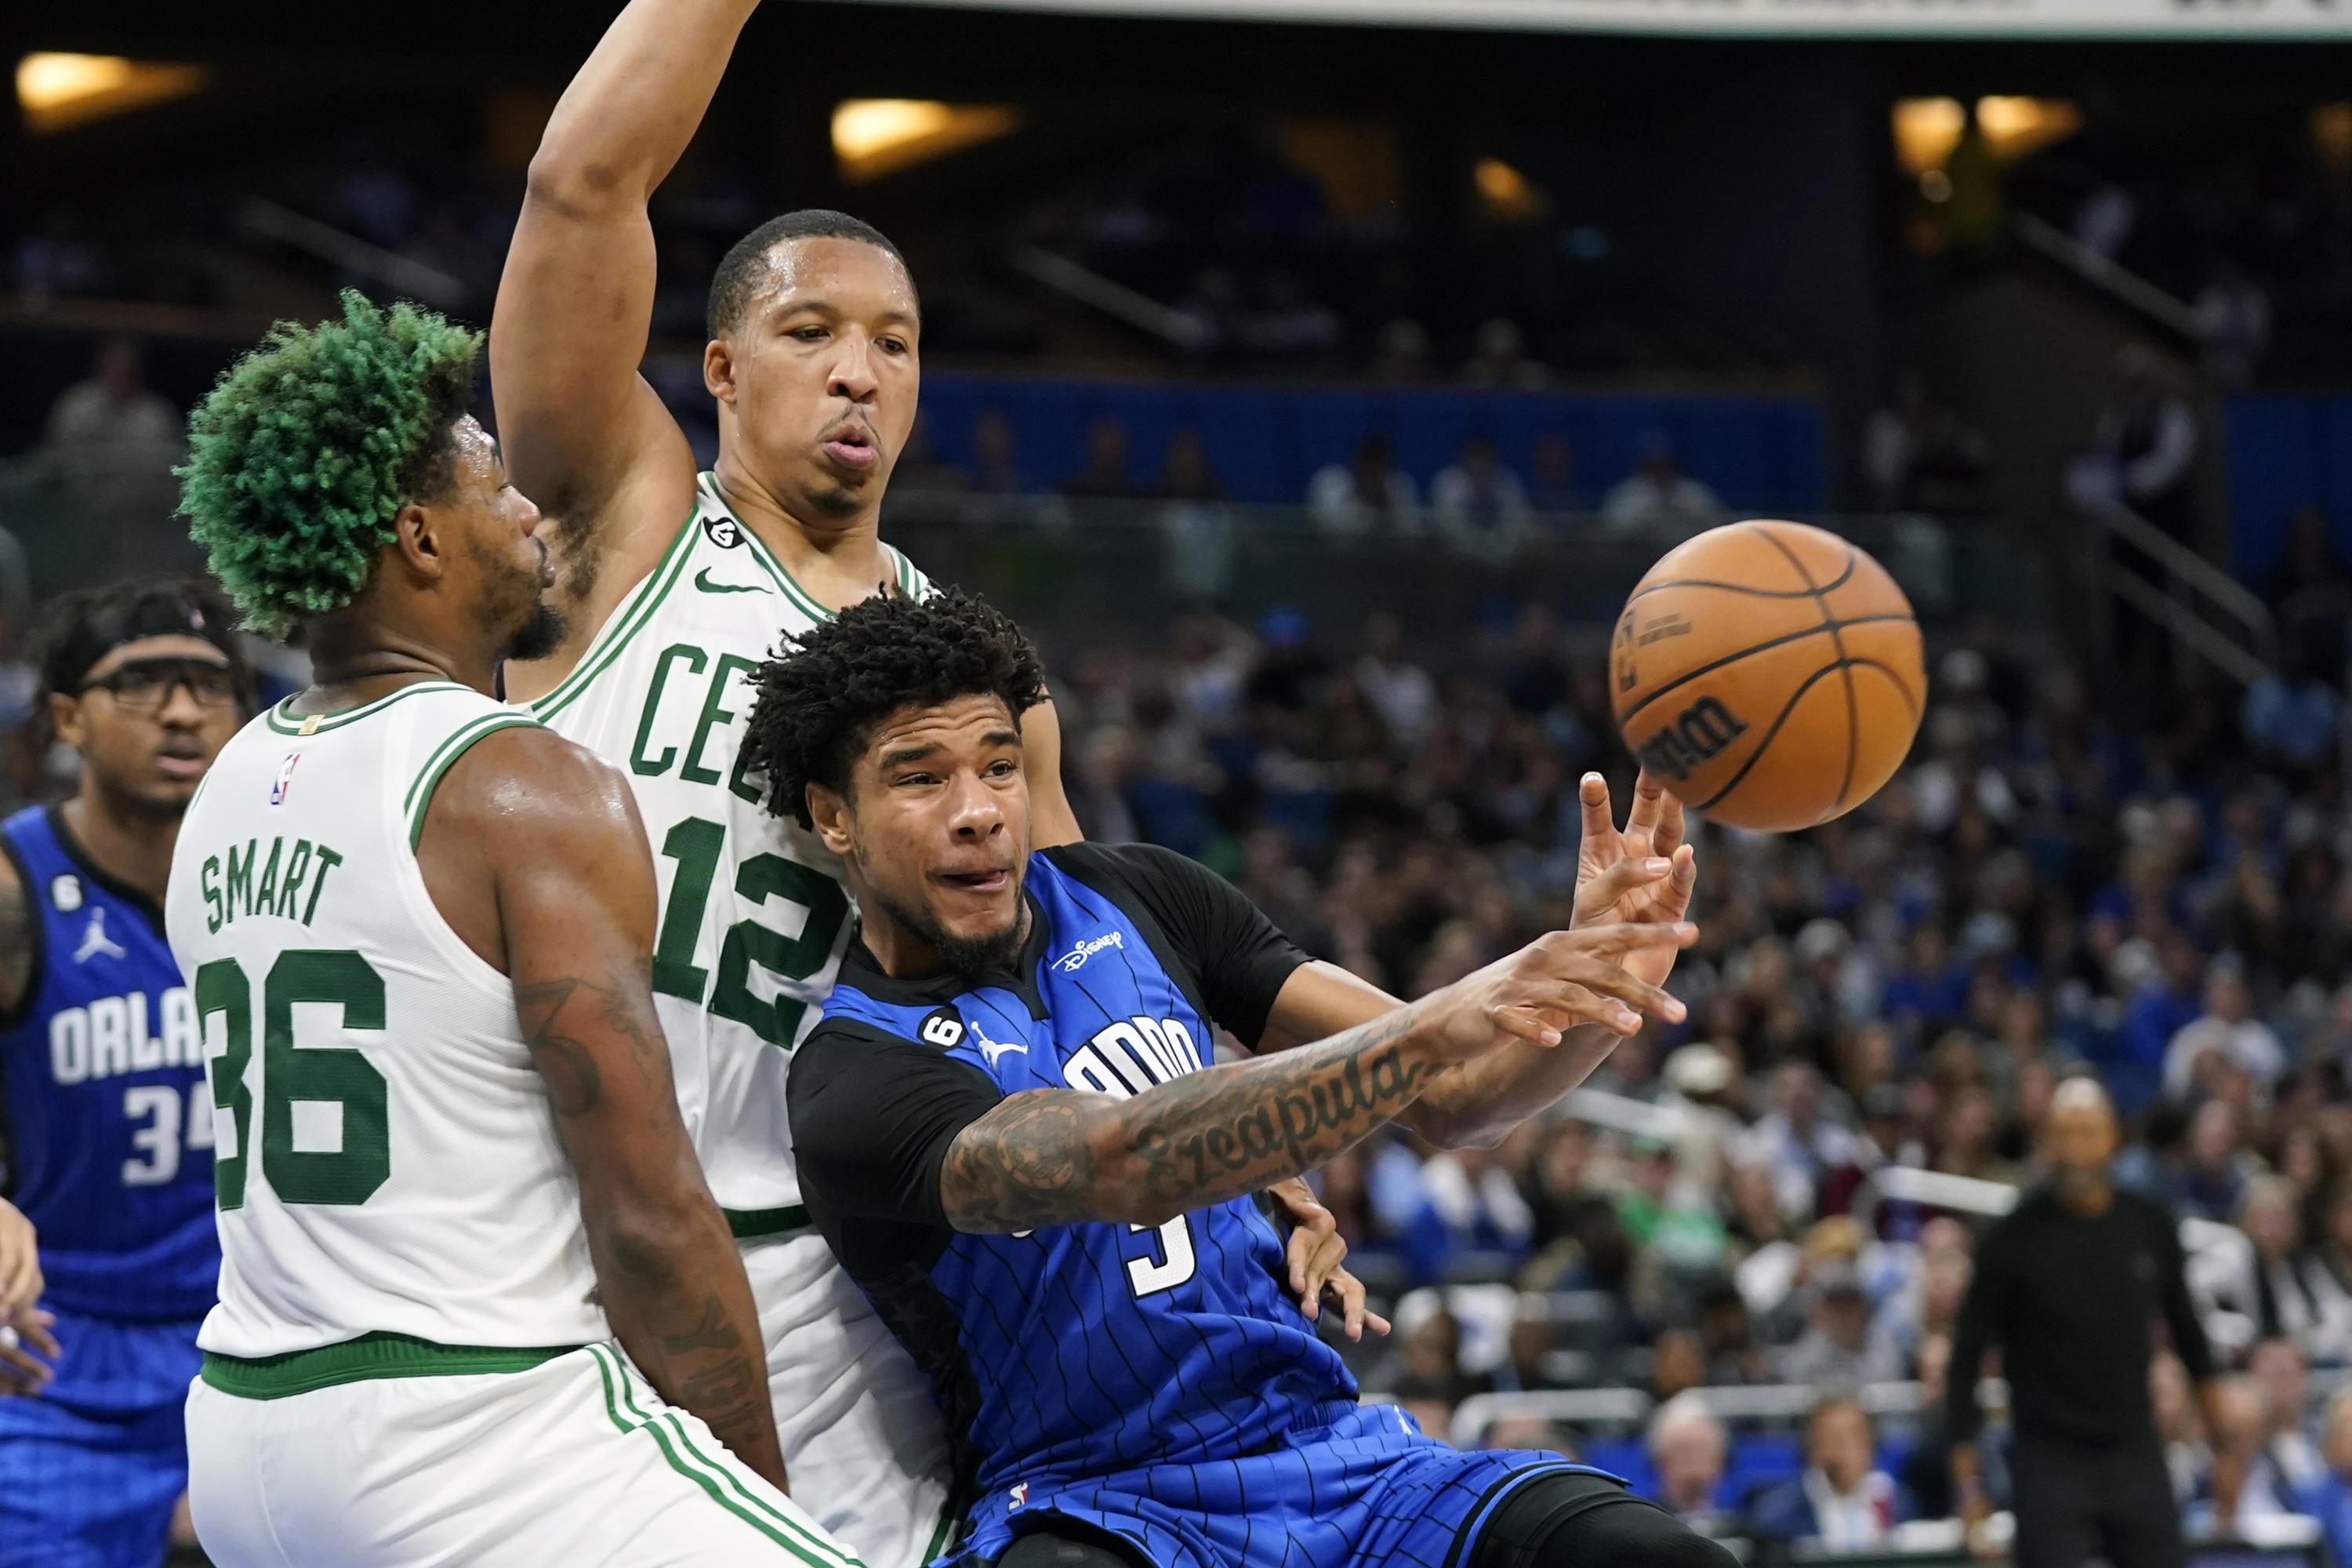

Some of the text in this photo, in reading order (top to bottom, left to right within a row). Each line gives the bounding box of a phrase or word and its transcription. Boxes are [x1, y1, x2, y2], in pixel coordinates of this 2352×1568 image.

[710, 521, 735, 546] 6
[201, 836, 343, 935] SMART
[652, 816, 849, 1051] 12
[1051, 931, 1123, 971] Disney
[923, 1016, 963, 1047] 6
[195, 949, 390, 1211] 36
